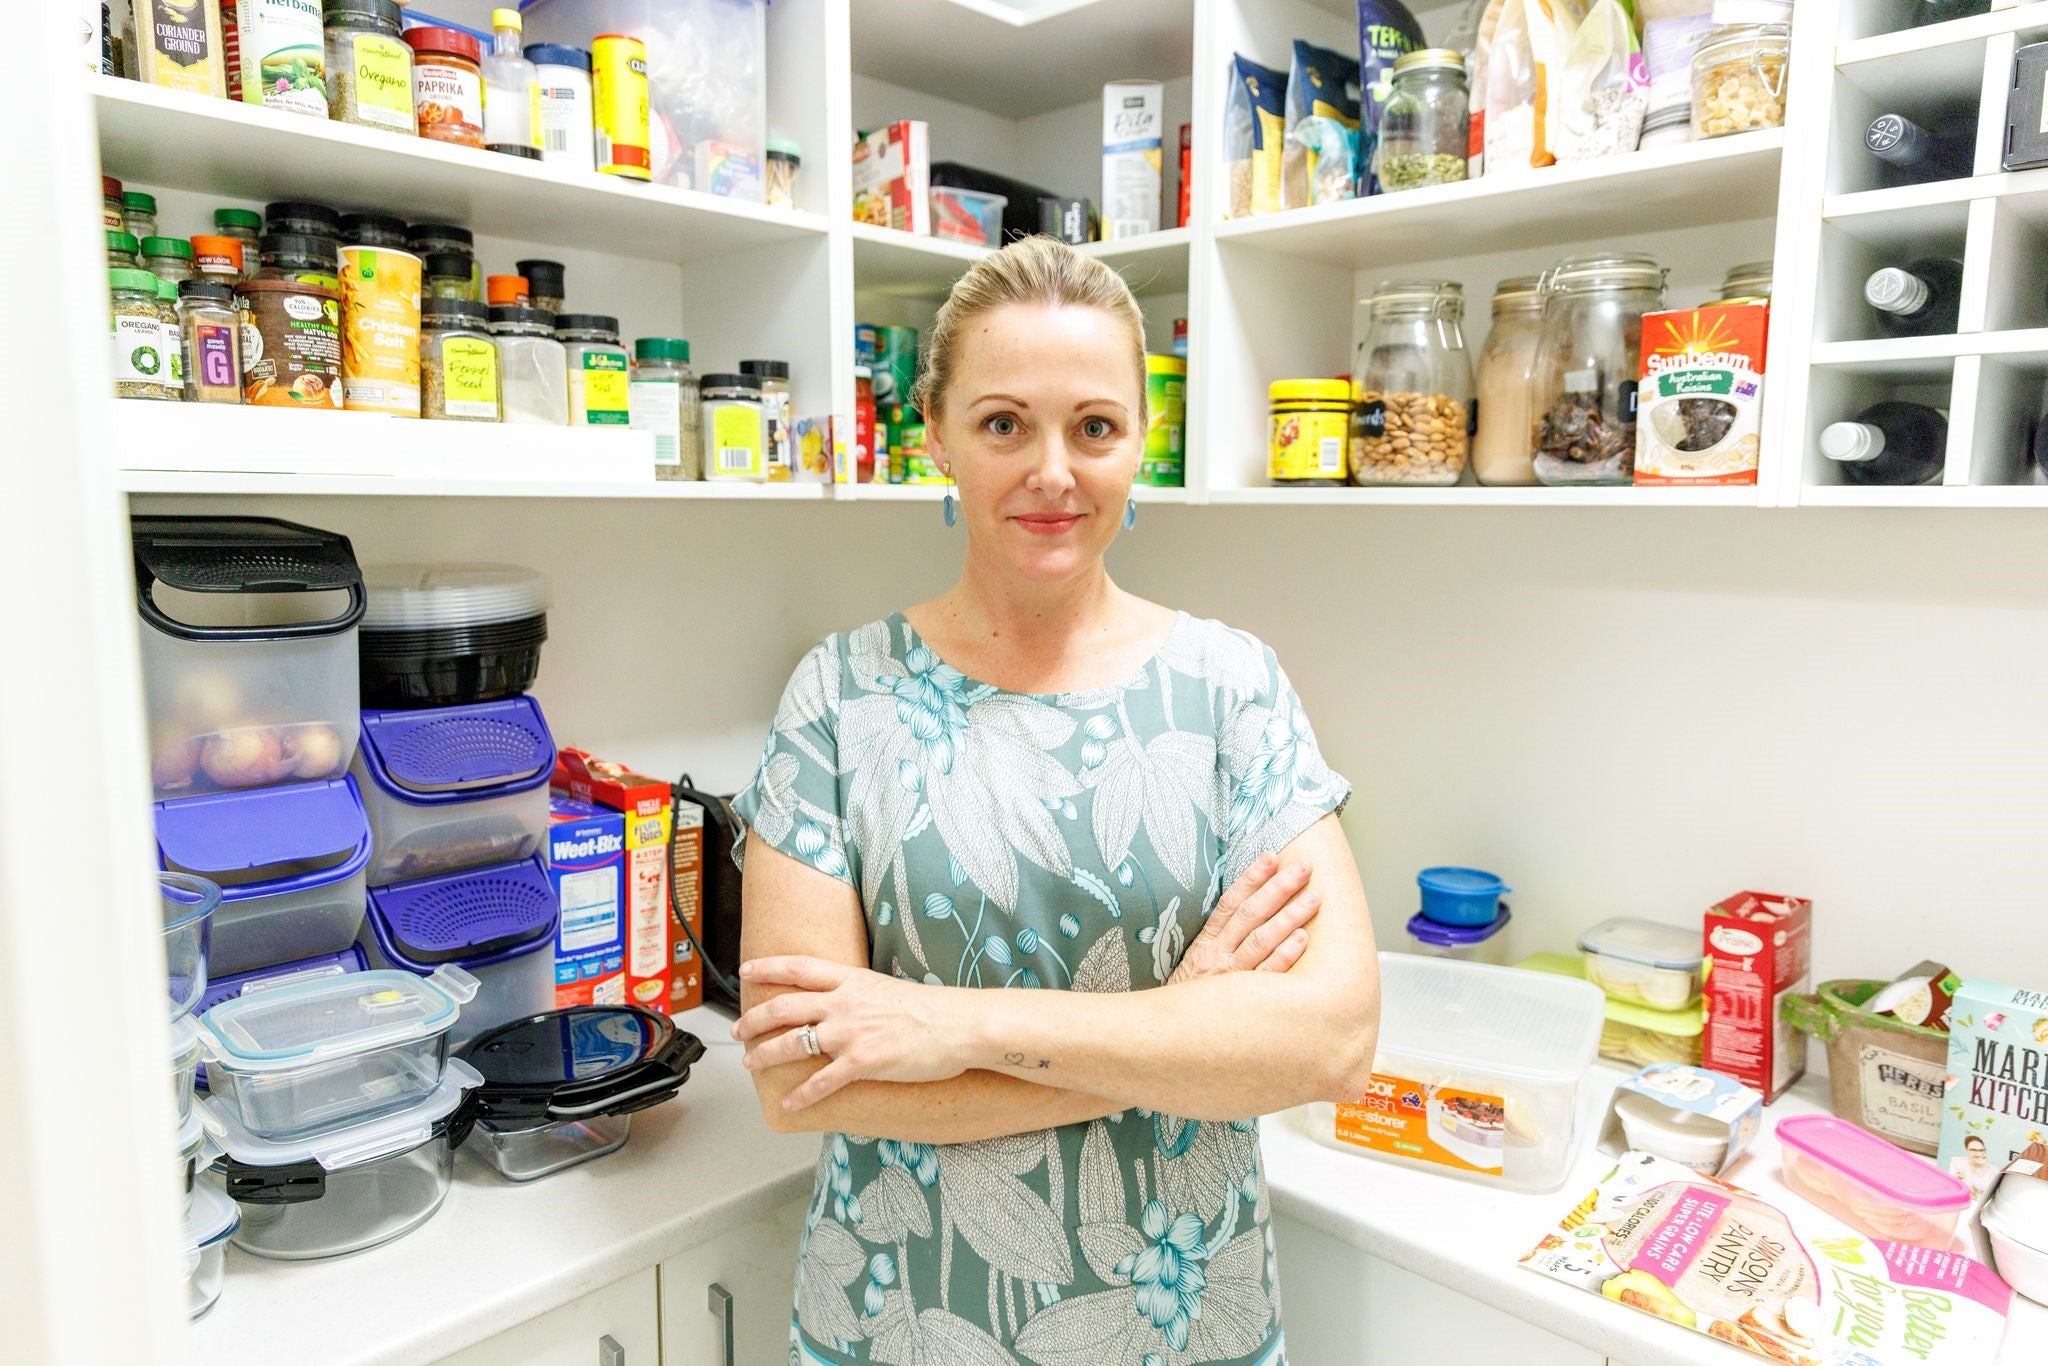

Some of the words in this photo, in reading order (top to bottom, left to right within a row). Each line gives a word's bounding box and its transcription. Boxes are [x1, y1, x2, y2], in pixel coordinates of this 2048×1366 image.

[157, 23, 206, 43] CORIANDER
[165, 37, 200, 55] GROUND
[360, 65, 407, 91] Oregano
[418, 80, 464, 96] PAPRIKA
[198, 255, 212, 264] NEW
[213, 256, 231, 265] LOOK
[289, 320, 320, 330] HEALTHY
[358, 317, 416, 337] Chicken
[374, 332, 406, 350] Salt
[206, 350, 230, 385] G
[448, 360, 491, 376] Fennel
[1647, 346, 1751, 376] Sunbeam
[456, 374, 483, 389] Seed
[1668, 371, 1723, 384] Australian
[636, 799, 660, 809] UNCLE
[553, 833, 623, 861] Weet-Bix
[639, 831, 664, 845] Bites
[1366, 1080, 1397, 1097] cor
[1880, 1065, 1943, 1098] HERBS
[1889, 1096, 1934, 1117] BASIL
[1671, 1198, 1699, 1228] SUPER
[1701, 1201, 1717, 1220] LITE
[1615, 1207, 1650, 1239] CALORIES
[1683, 1222, 1703, 1244] LOW
[1646, 1225, 1680, 1260] GRAINS
[1699, 1219, 1754, 1283] PANTRY
[1661, 1243, 1687, 1272] CARB
[1727, 1235, 1785, 1297] SIMSON'S
[1832, 1265, 1896, 1307] for
[1833, 1290, 1885, 1348] you
[1901, 1289, 1952, 1360] Better
